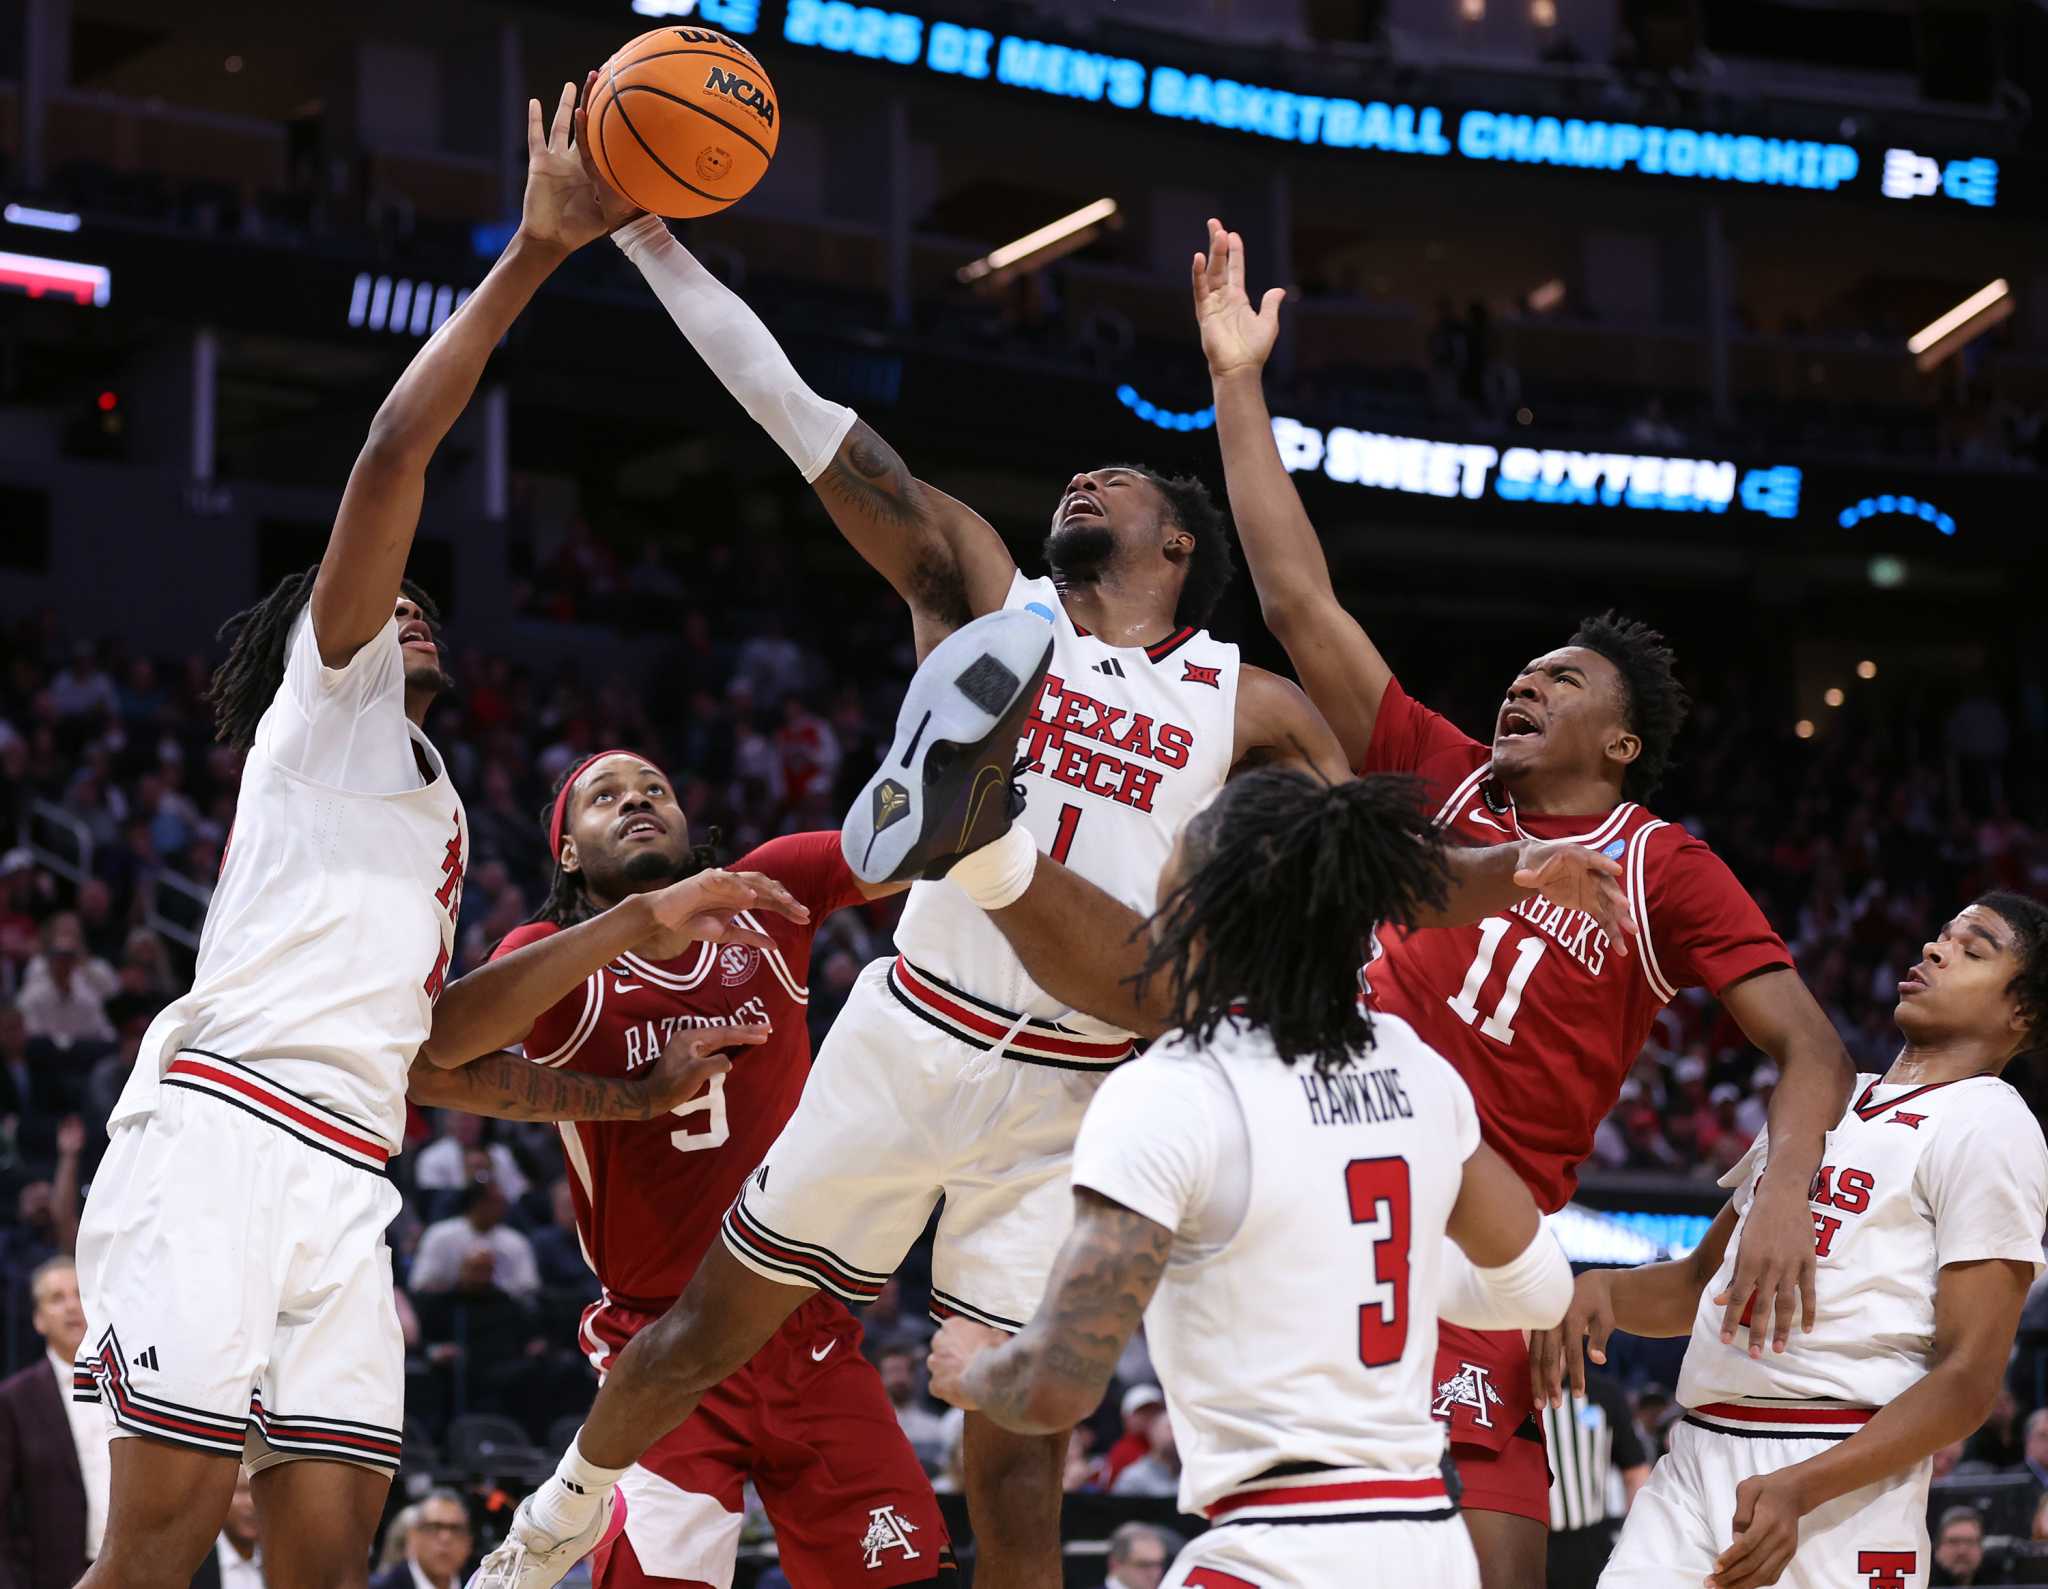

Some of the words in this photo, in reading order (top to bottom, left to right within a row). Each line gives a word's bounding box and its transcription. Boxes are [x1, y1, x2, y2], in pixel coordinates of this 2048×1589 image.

[704, 66, 774, 128] NCAA
[784, 0, 923, 64] 2025
[927, 22, 994, 79] DI
[996, 36, 1146, 108] MEN'S
[1149, 67, 1451, 155] BASKETBALL
[1458, 111, 1859, 190] CHAMPIONSHIP
[1324, 427, 1498, 499] SWEET
[1496, 447, 1736, 513] SIXTEEN
[1023, 719, 1163, 814] TECH
[1033, 674, 1193, 770] TEXAS
[1050, 803, 1083, 865] 1
[719, 945, 749, 975] SEC
[1446, 916, 1547, 1046] 11
[1300, 1068, 1413, 1125] HAWKINS
[1344, 1155, 1411, 1369] 3
